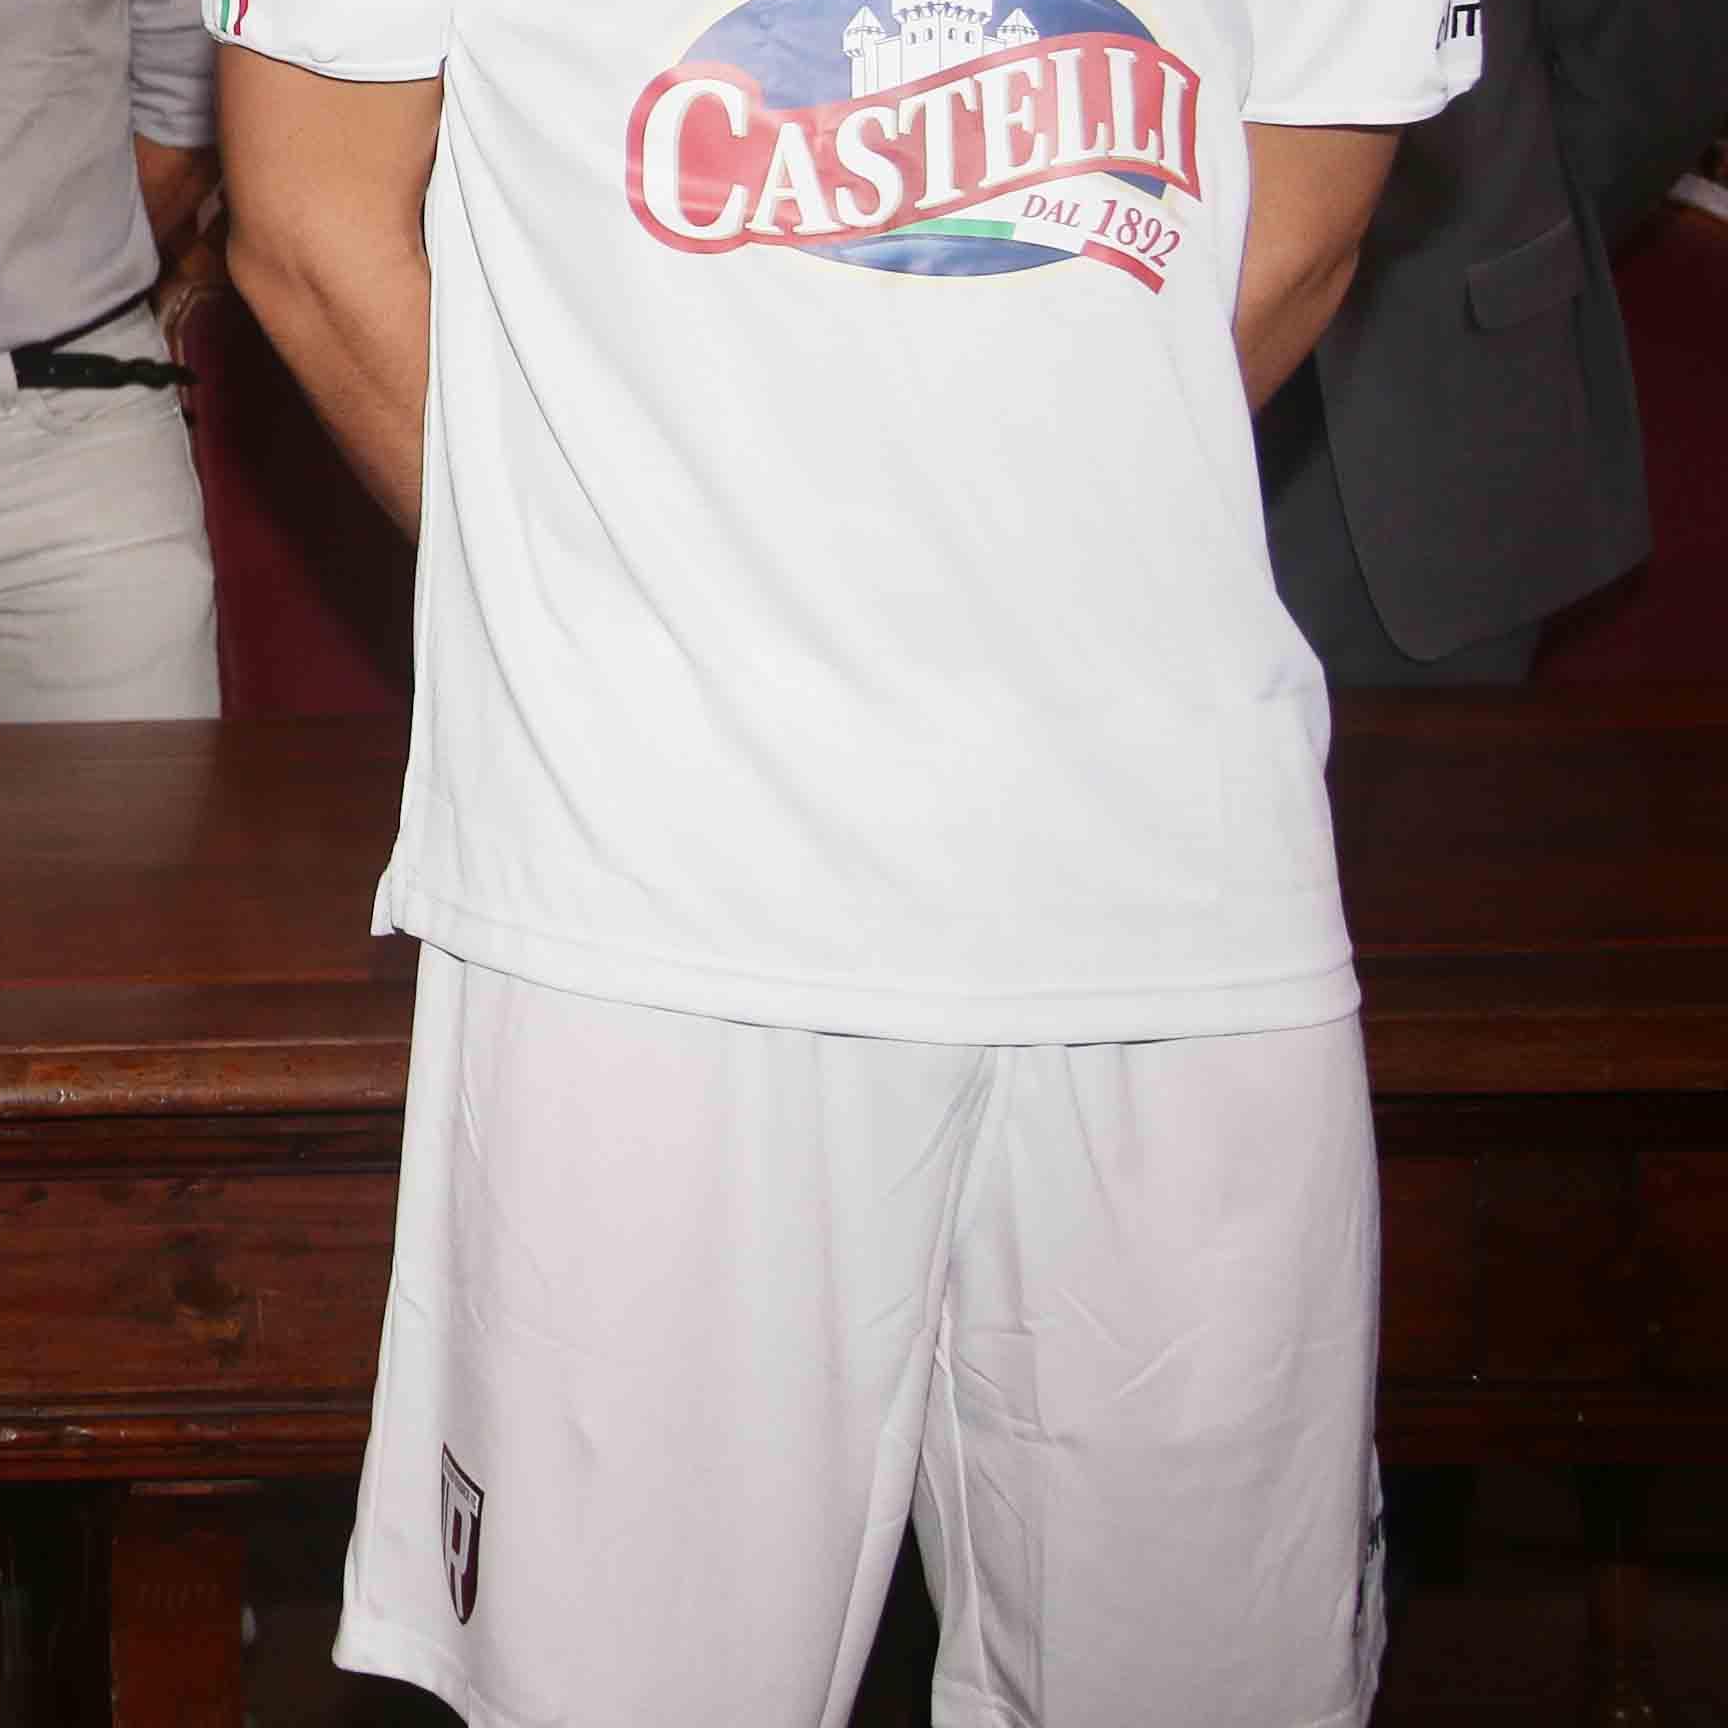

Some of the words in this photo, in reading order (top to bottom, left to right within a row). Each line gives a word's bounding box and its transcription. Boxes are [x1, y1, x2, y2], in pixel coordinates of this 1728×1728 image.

[641, 46, 1192, 239] CASTELLI
[1022, 194, 1082, 227] DAL
[1092, 199, 1181, 269] 1892
